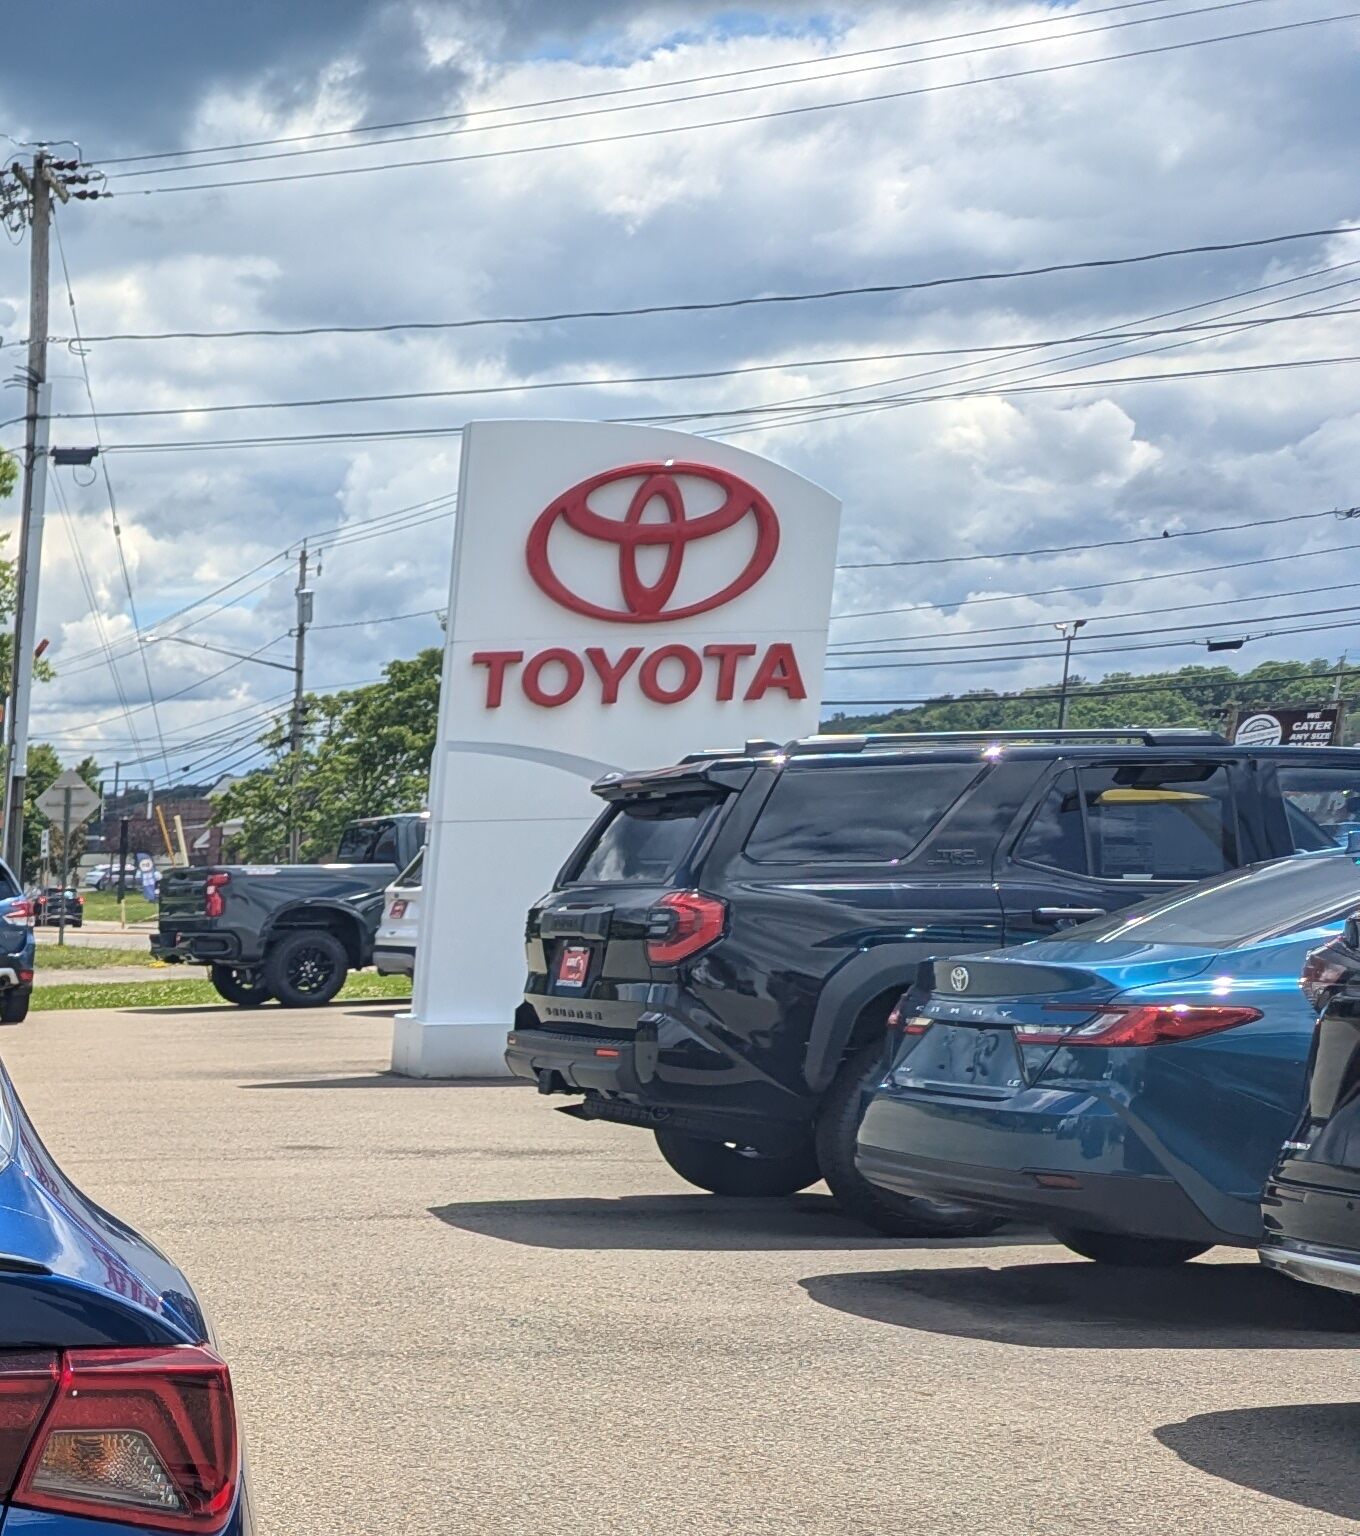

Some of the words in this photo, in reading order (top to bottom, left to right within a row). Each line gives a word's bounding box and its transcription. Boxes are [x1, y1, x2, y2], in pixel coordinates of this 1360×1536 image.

[472, 643, 808, 709] TOYOTA
[1292, 721, 1332, 731] CATER
[1310, 732, 1331, 740] SIZE
[1007, 1079, 1021, 1087] LE
